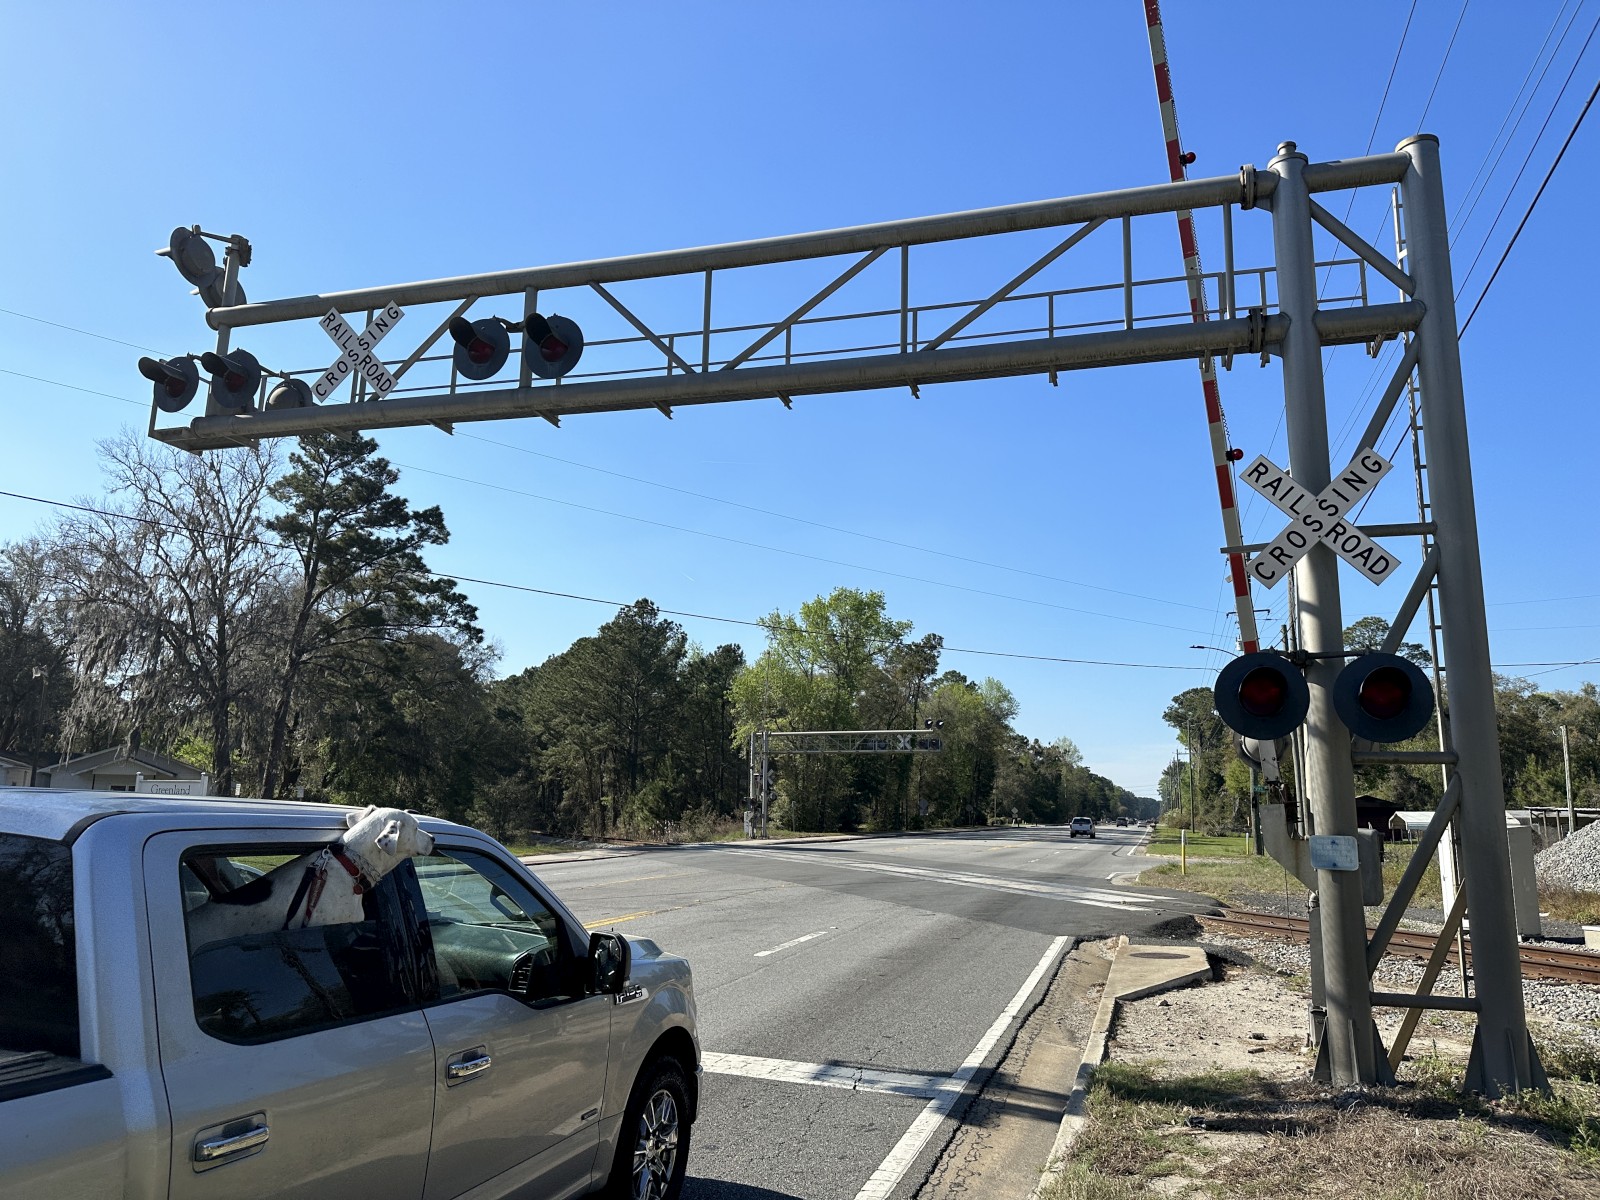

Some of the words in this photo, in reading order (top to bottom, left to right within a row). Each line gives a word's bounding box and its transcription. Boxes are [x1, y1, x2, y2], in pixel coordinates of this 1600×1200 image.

[315, 306, 399, 397] CROSSING
[1254, 455, 1383, 580] CROSSING
[150, 783, 191, 795] Greenland
